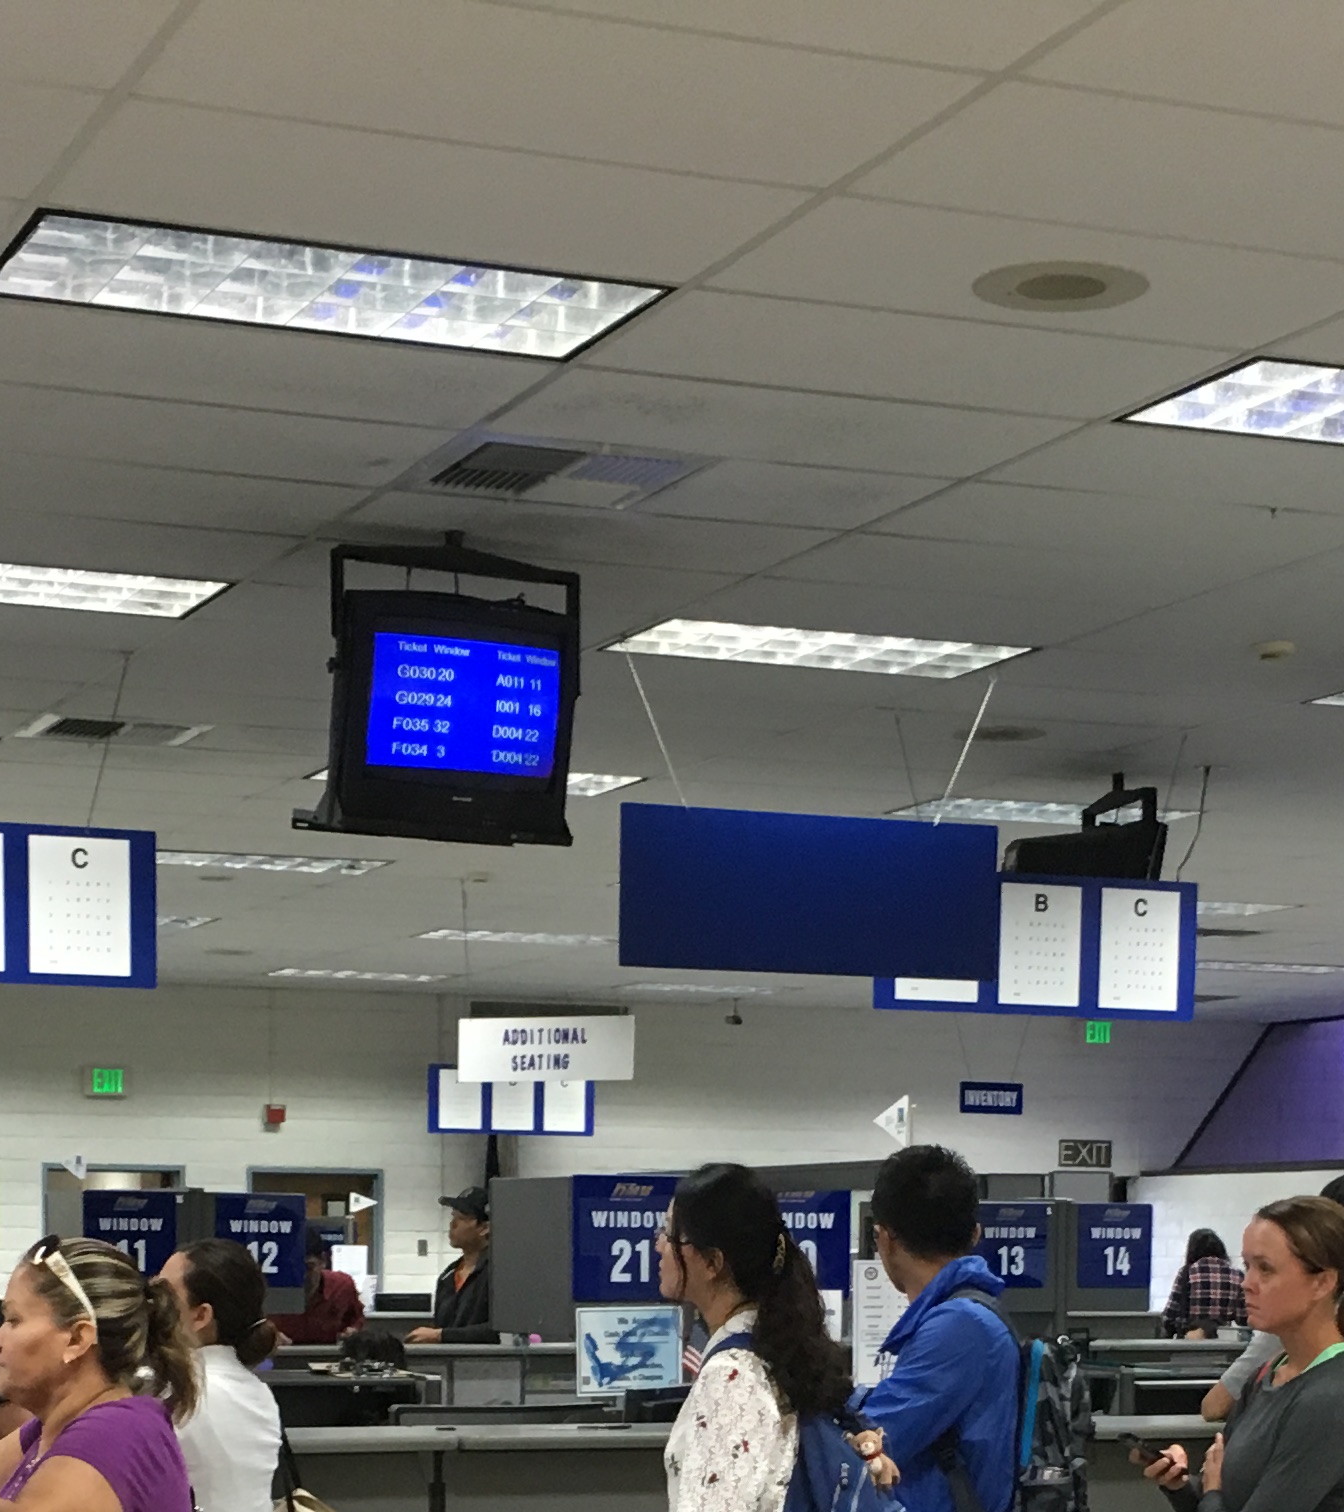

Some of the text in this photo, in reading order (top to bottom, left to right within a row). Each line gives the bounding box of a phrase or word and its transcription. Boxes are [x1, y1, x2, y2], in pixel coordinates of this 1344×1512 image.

[529, 678, 542, 692] 11
[433, 719, 451, 734] 32
[71, 848, 89, 869] C
[1034, 893, 1049, 913] B
[1134, 898, 1148, 917] C
[502, 1027, 588, 1047] ADDITIONAL
[511, 1053, 570, 1073] SEATING
[964, 1089, 1019, 1107] INVENTORY
[1060, 1142, 1110, 1165] EXIT
[99, 1217, 163, 1231] WINDOW
[230, 1219, 293, 1233] WINDOW
[782, 1212, 835, 1229] NDOW
[984, 1226, 1037, 1239] WINDOW
[1090, 1227, 1142, 1240] WINDOW
[247, 1241, 279, 1274] 12
[609, 1239, 650, 1283] 21
[997, 1245, 1024, 1276] 13
[1104, 1246, 1131, 1276] 14
